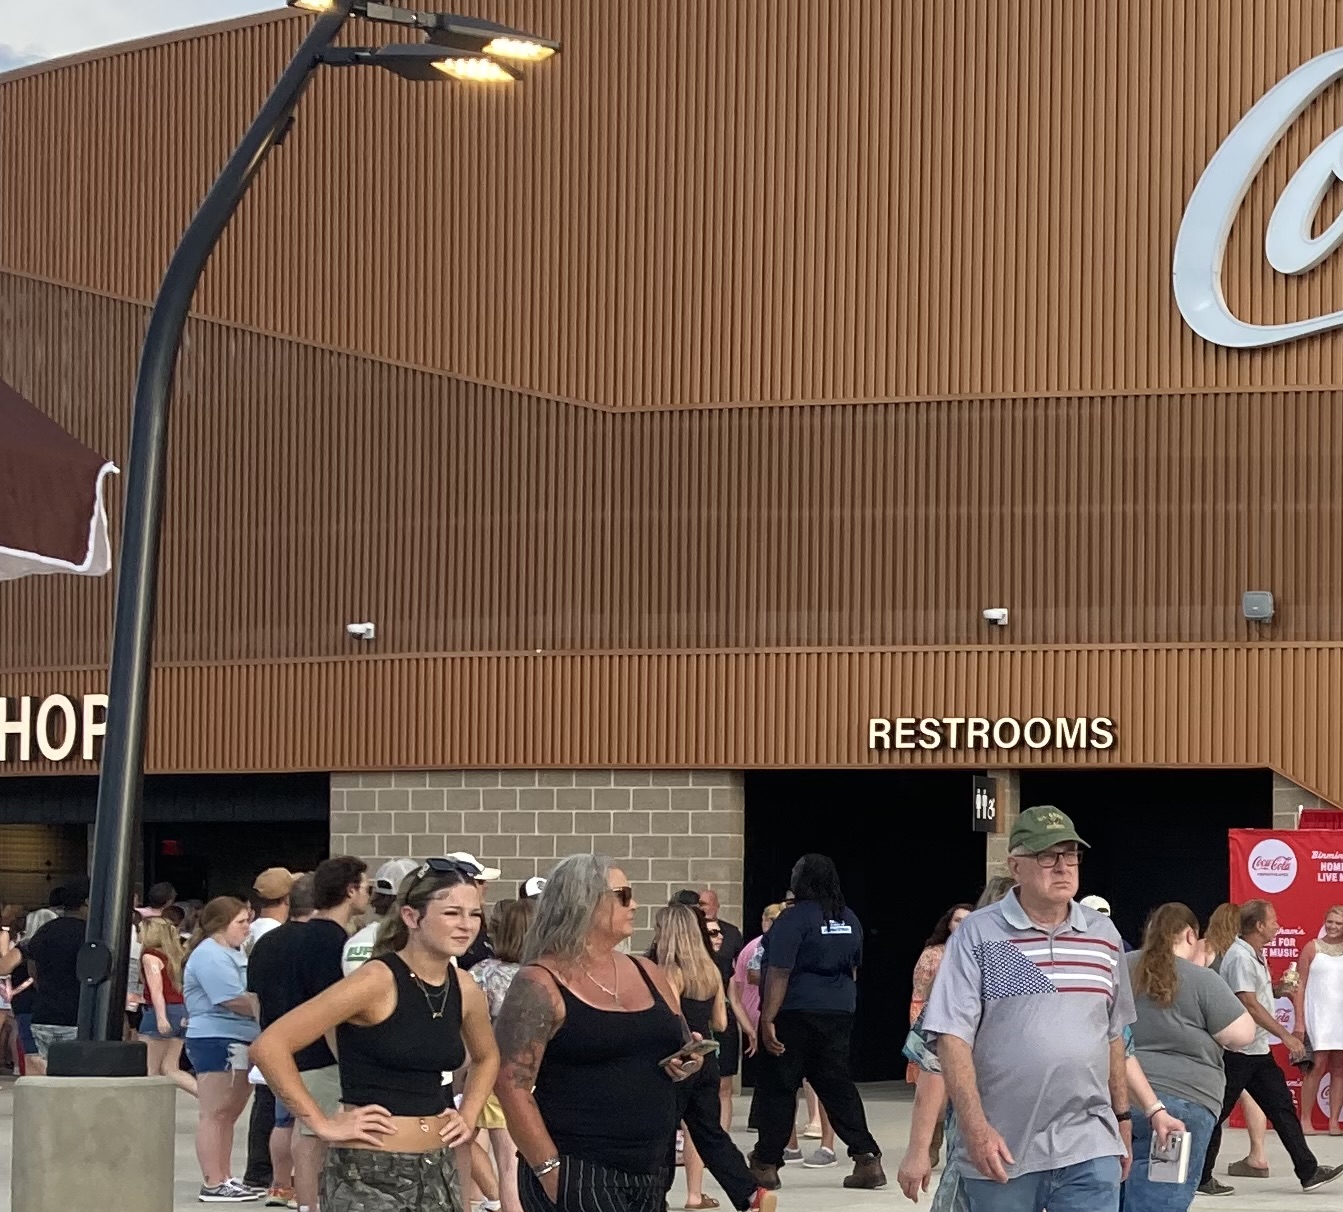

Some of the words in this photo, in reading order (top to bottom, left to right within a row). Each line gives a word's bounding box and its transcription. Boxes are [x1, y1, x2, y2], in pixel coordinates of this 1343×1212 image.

[868, 717, 1115, 749] RESTROOMS
[1317, 873, 1338, 882] LIVE
[1278, 938, 1296, 947] FOR
[1270, 948, 1299, 958] MUSIC
